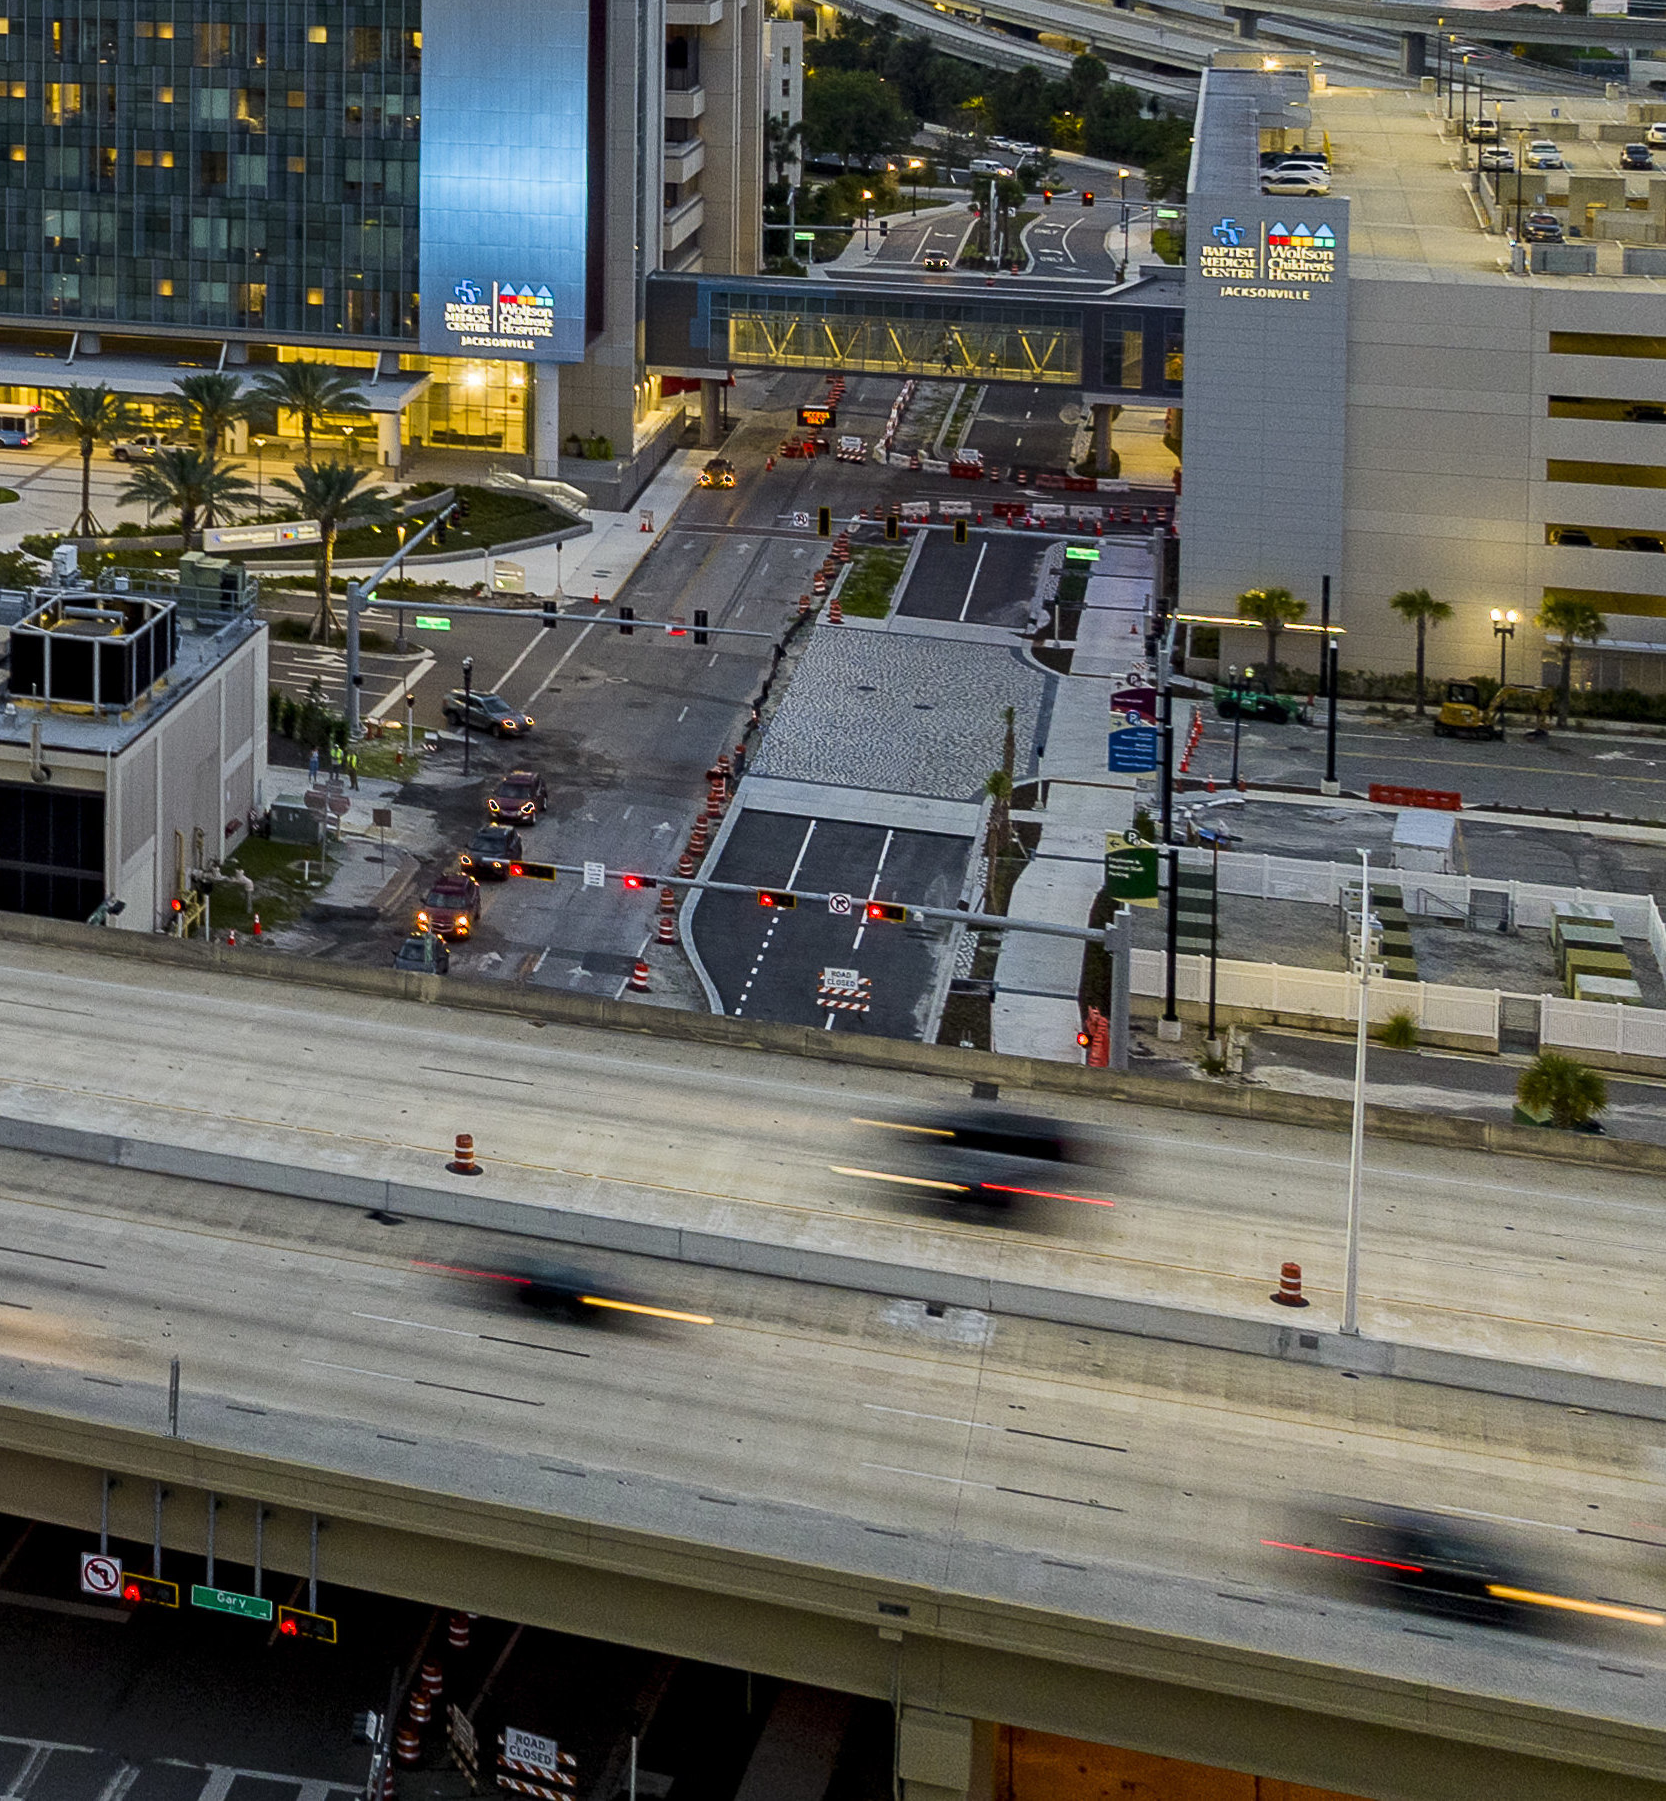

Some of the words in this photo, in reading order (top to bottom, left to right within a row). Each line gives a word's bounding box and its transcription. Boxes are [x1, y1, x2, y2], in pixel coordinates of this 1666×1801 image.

[1201, 245, 1256, 258] BAPTIST
[1269, 245, 1335, 261] Wolfson
[1200, 256, 1258, 269] MEDICAL
[1268, 258, 1335, 272] Children's
[1202, 267, 1254, 279] CENTER
[1269, 269, 1333, 283] HOSPITAL
[1220, 286, 1310, 301] JACKSONVILLE
[460, 336, 535, 350] JACKSONVILLE
[831, 970, 852, 979] ROAD
[827, 978, 856, 987] CLOSED
[216, 1591, 247, 1609] Gary
[516, 1732, 547, 1750] ROAD
[509, 1744, 553, 1766] CLOSED
